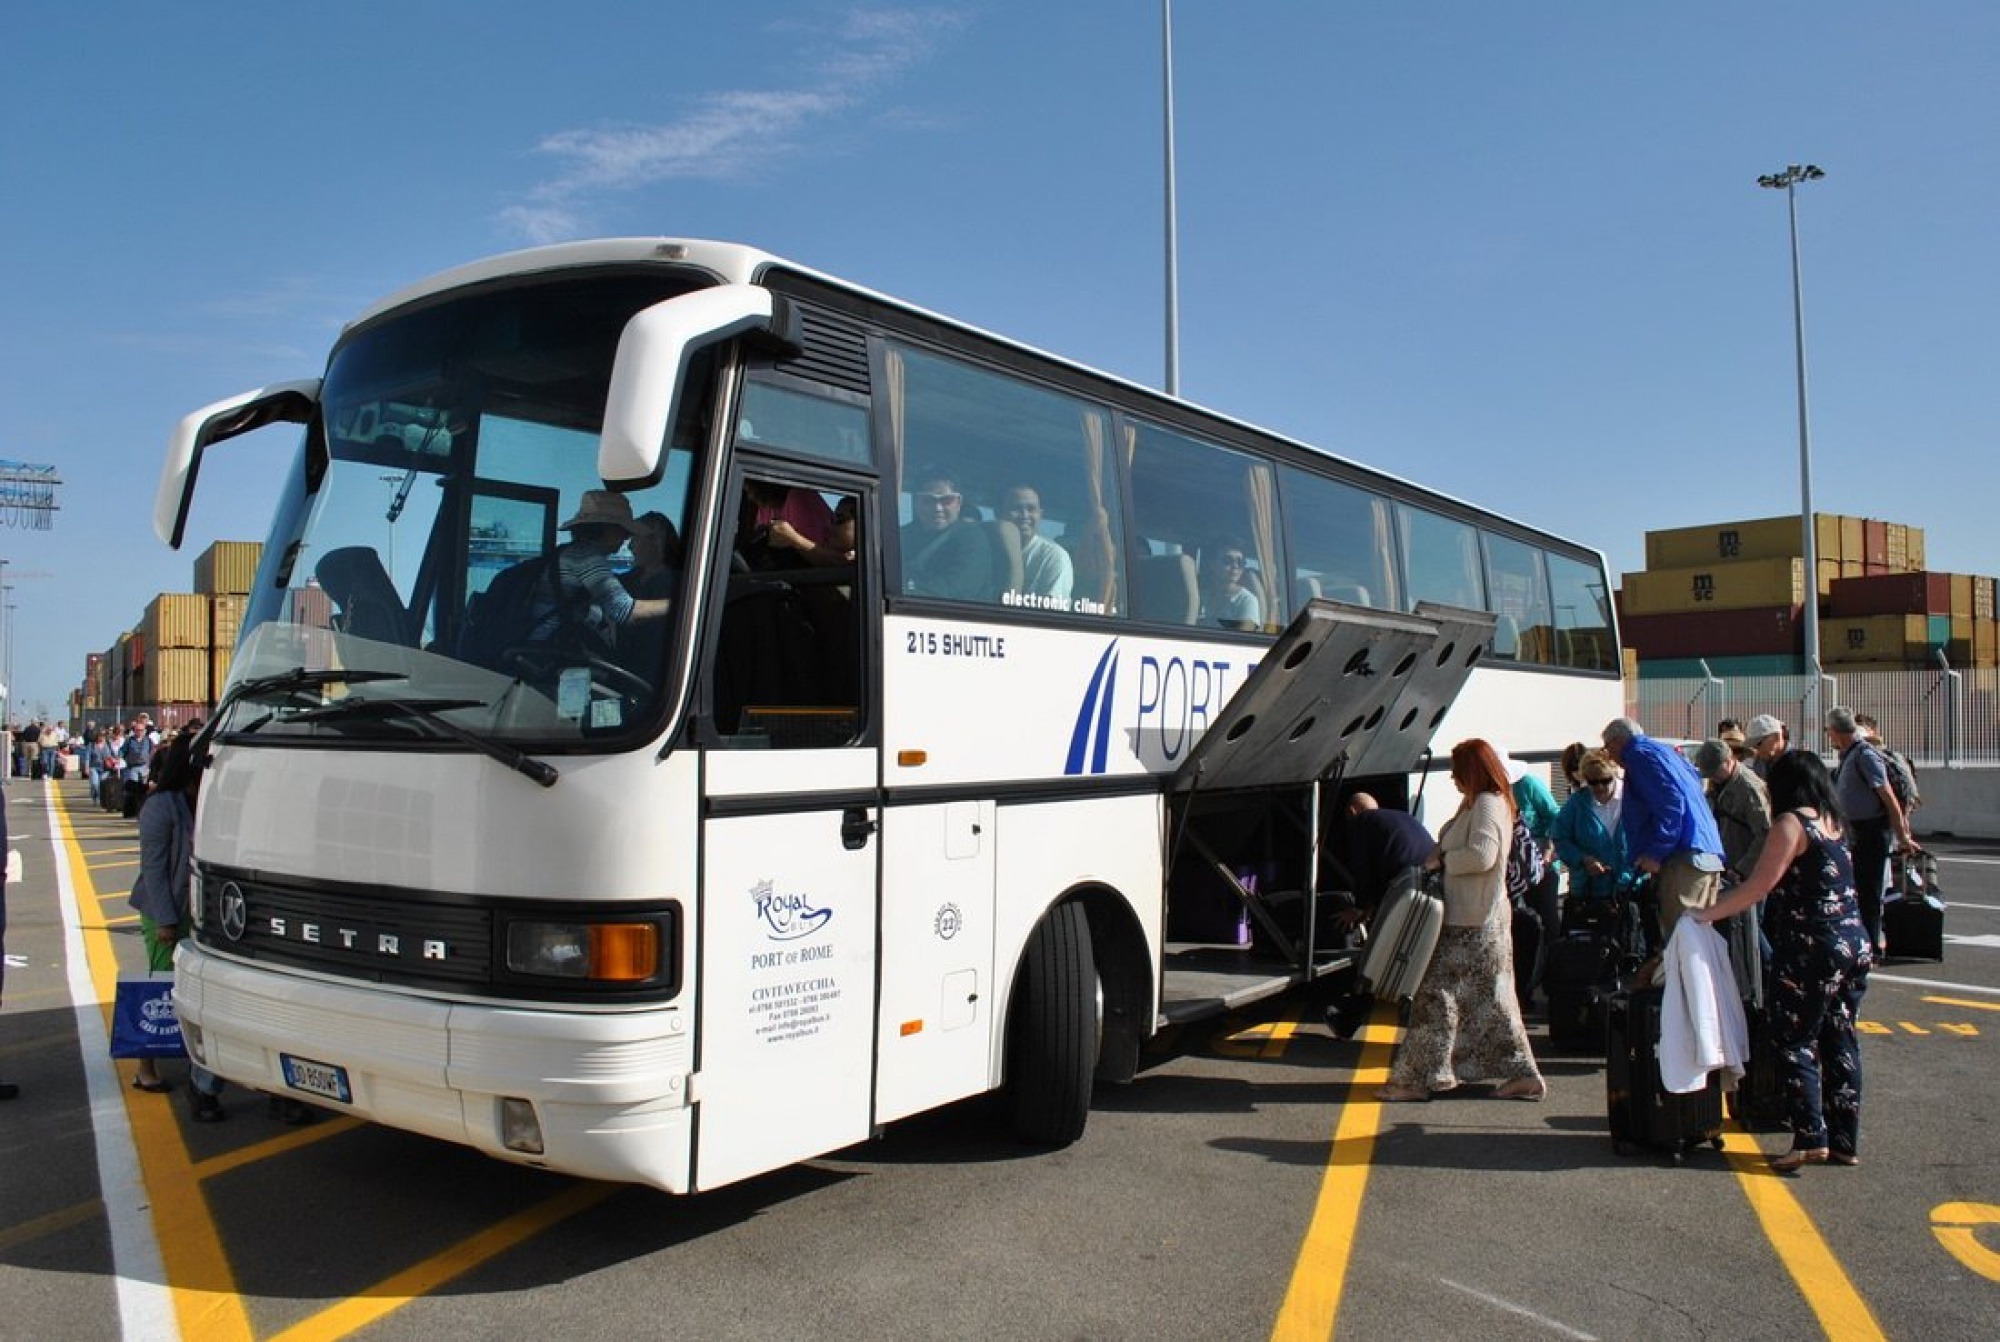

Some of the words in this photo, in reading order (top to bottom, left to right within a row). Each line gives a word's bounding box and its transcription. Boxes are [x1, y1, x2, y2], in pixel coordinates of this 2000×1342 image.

[1002, 588, 1071, 612] electronic
[1074, 597, 1105, 615] clima
[907, 631, 937, 655] 215
[943, 634, 1005, 658] SHUTTLE
[1136, 656, 1231, 760] PORT
[270, 917, 446, 961] SETRA
[752, 951, 784, 969] PORT
[800, 944, 833, 962] ROME
[752, 977, 835, 1000] CIVITAVECCHIA
